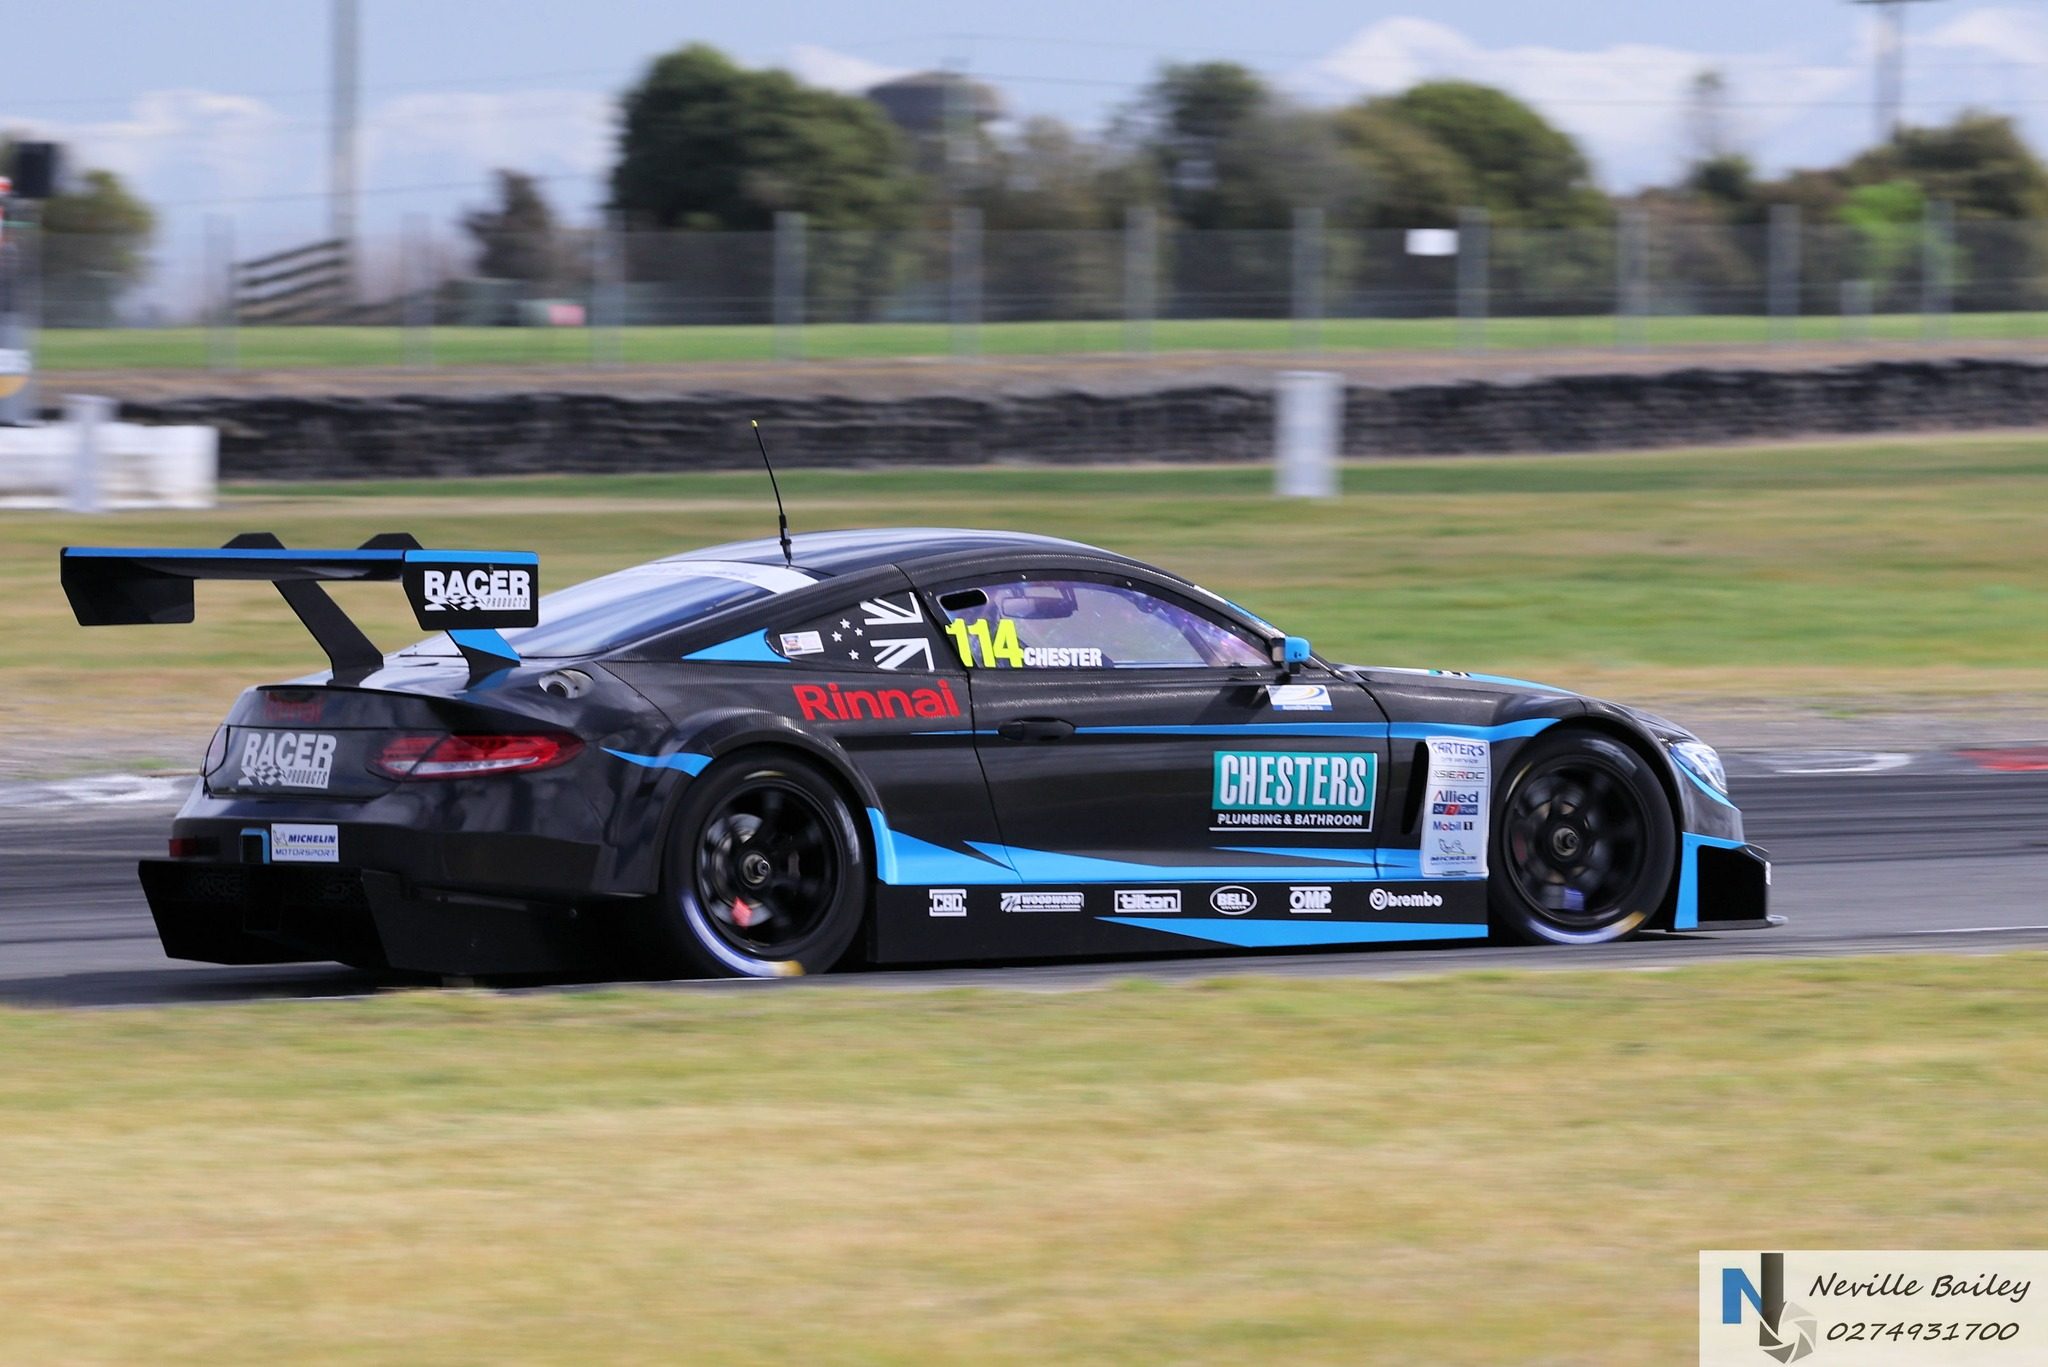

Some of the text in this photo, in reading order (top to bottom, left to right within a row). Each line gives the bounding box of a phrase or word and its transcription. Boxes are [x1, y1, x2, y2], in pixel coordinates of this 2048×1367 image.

[424, 570, 531, 597] RACER
[487, 597, 528, 608] PRODUCTS
[945, 618, 1102, 668] 114 CHESTER
[792, 678, 961, 721] Rinnai
[241, 733, 337, 769] RACER
[1432, 742, 1485, 757] CARTER'S
[286, 768, 329, 786] PRODUCTS
[1220, 754, 1368, 807] CHESTERS
[1434, 790, 1479, 803] Allied
[1218, 814, 1363, 826] PLUMBING & BATHROOM
[1433, 820, 1462, 831] Mobil
[288, 834, 336, 843] MICHELIN
[275, 848, 336, 857] MOTORSPORT
[1120, 894, 1176, 910] tilton
[1217, 893, 1251, 906] BELL
[1290, 891, 1332, 909] OMP
[1388, 892, 1443, 907] brembo
